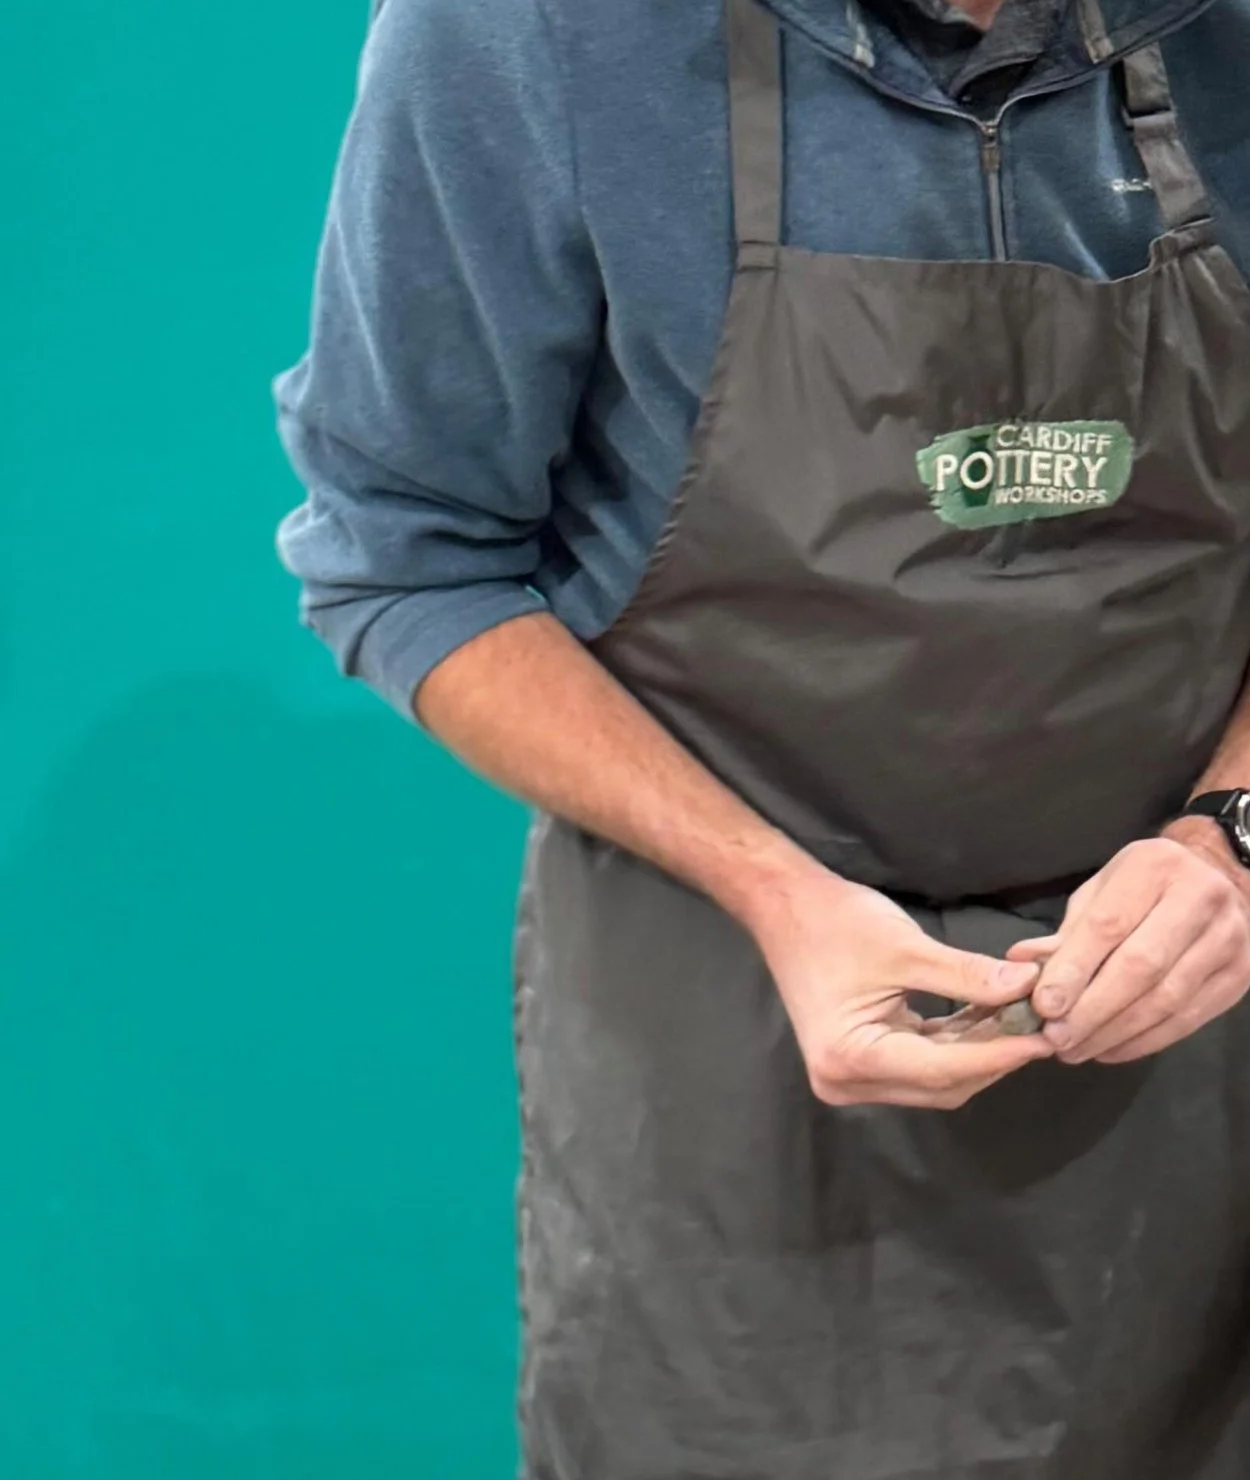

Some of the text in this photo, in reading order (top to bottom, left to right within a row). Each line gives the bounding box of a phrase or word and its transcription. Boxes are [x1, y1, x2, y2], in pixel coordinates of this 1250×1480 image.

[996, 424, 1113, 455] CARDIFF
[934, 449, 1109, 492] POTTERY
[994, 486, 1108, 505] WORKSHOPS
